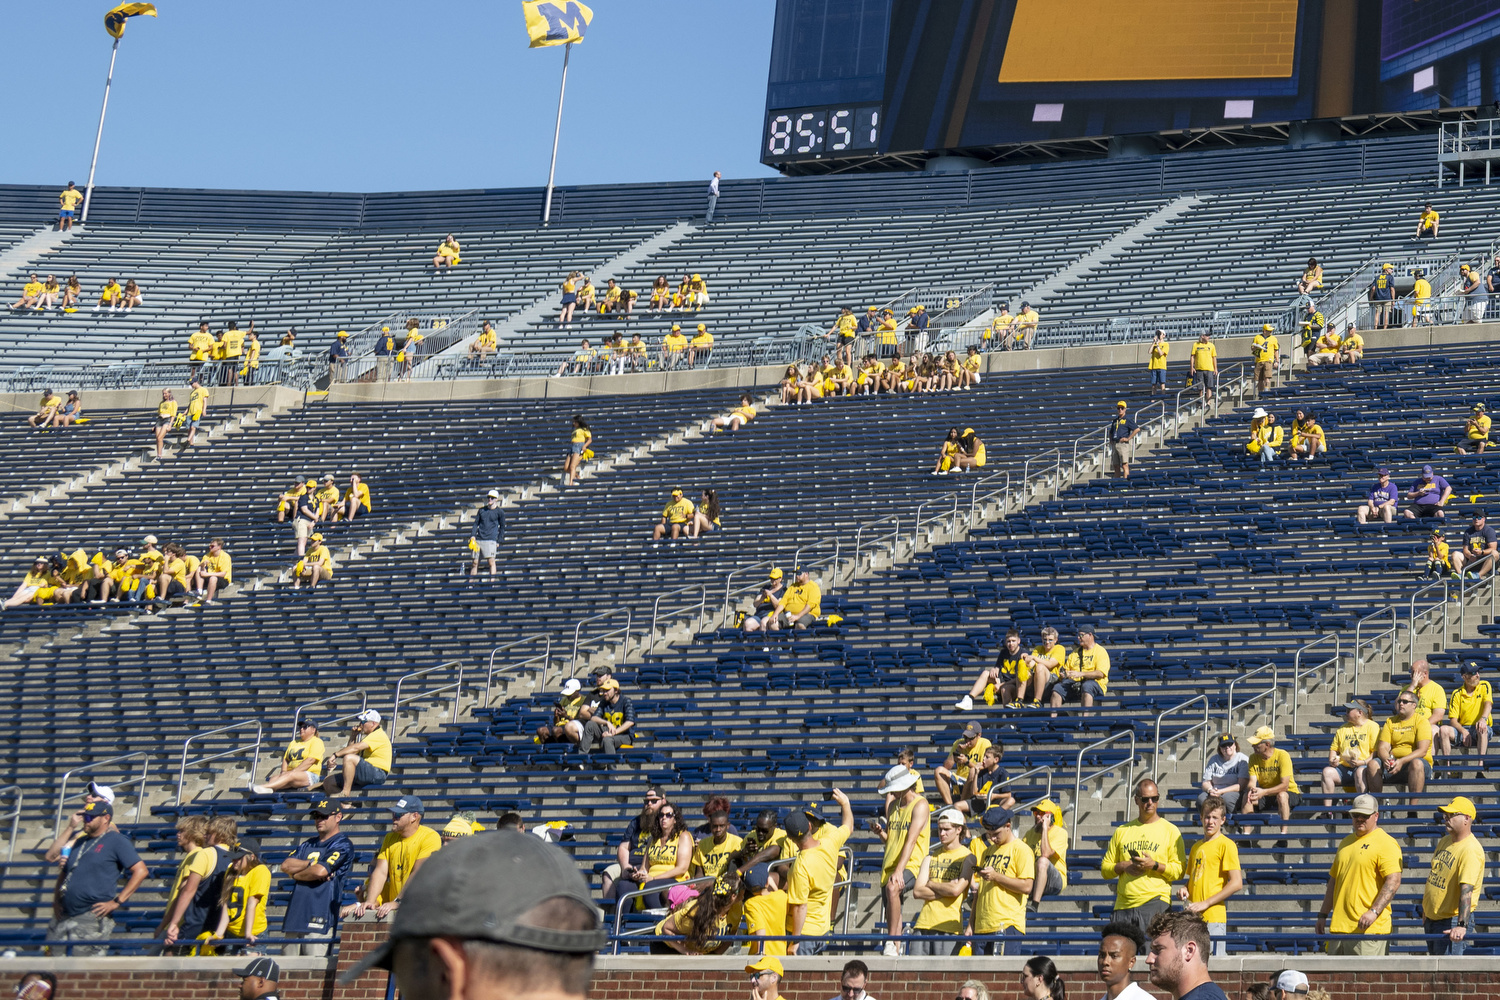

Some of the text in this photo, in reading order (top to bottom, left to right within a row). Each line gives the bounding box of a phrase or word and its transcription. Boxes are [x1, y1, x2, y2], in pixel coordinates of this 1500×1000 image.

[537, 1, 588, 40] M
[769, 111, 878, 155] 85:51
[946, 299, 960, 309] 33
[432, 321, 447, 329] 32
[288, 747, 304, 761] M
[648, 845, 677, 857] 2023
[1123, 840, 1160, 853] MICHIGAN
[326, 851, 340, 865] 2
[1195, 858, 1203, 866] M
[228, 886, 245, 922] 9
